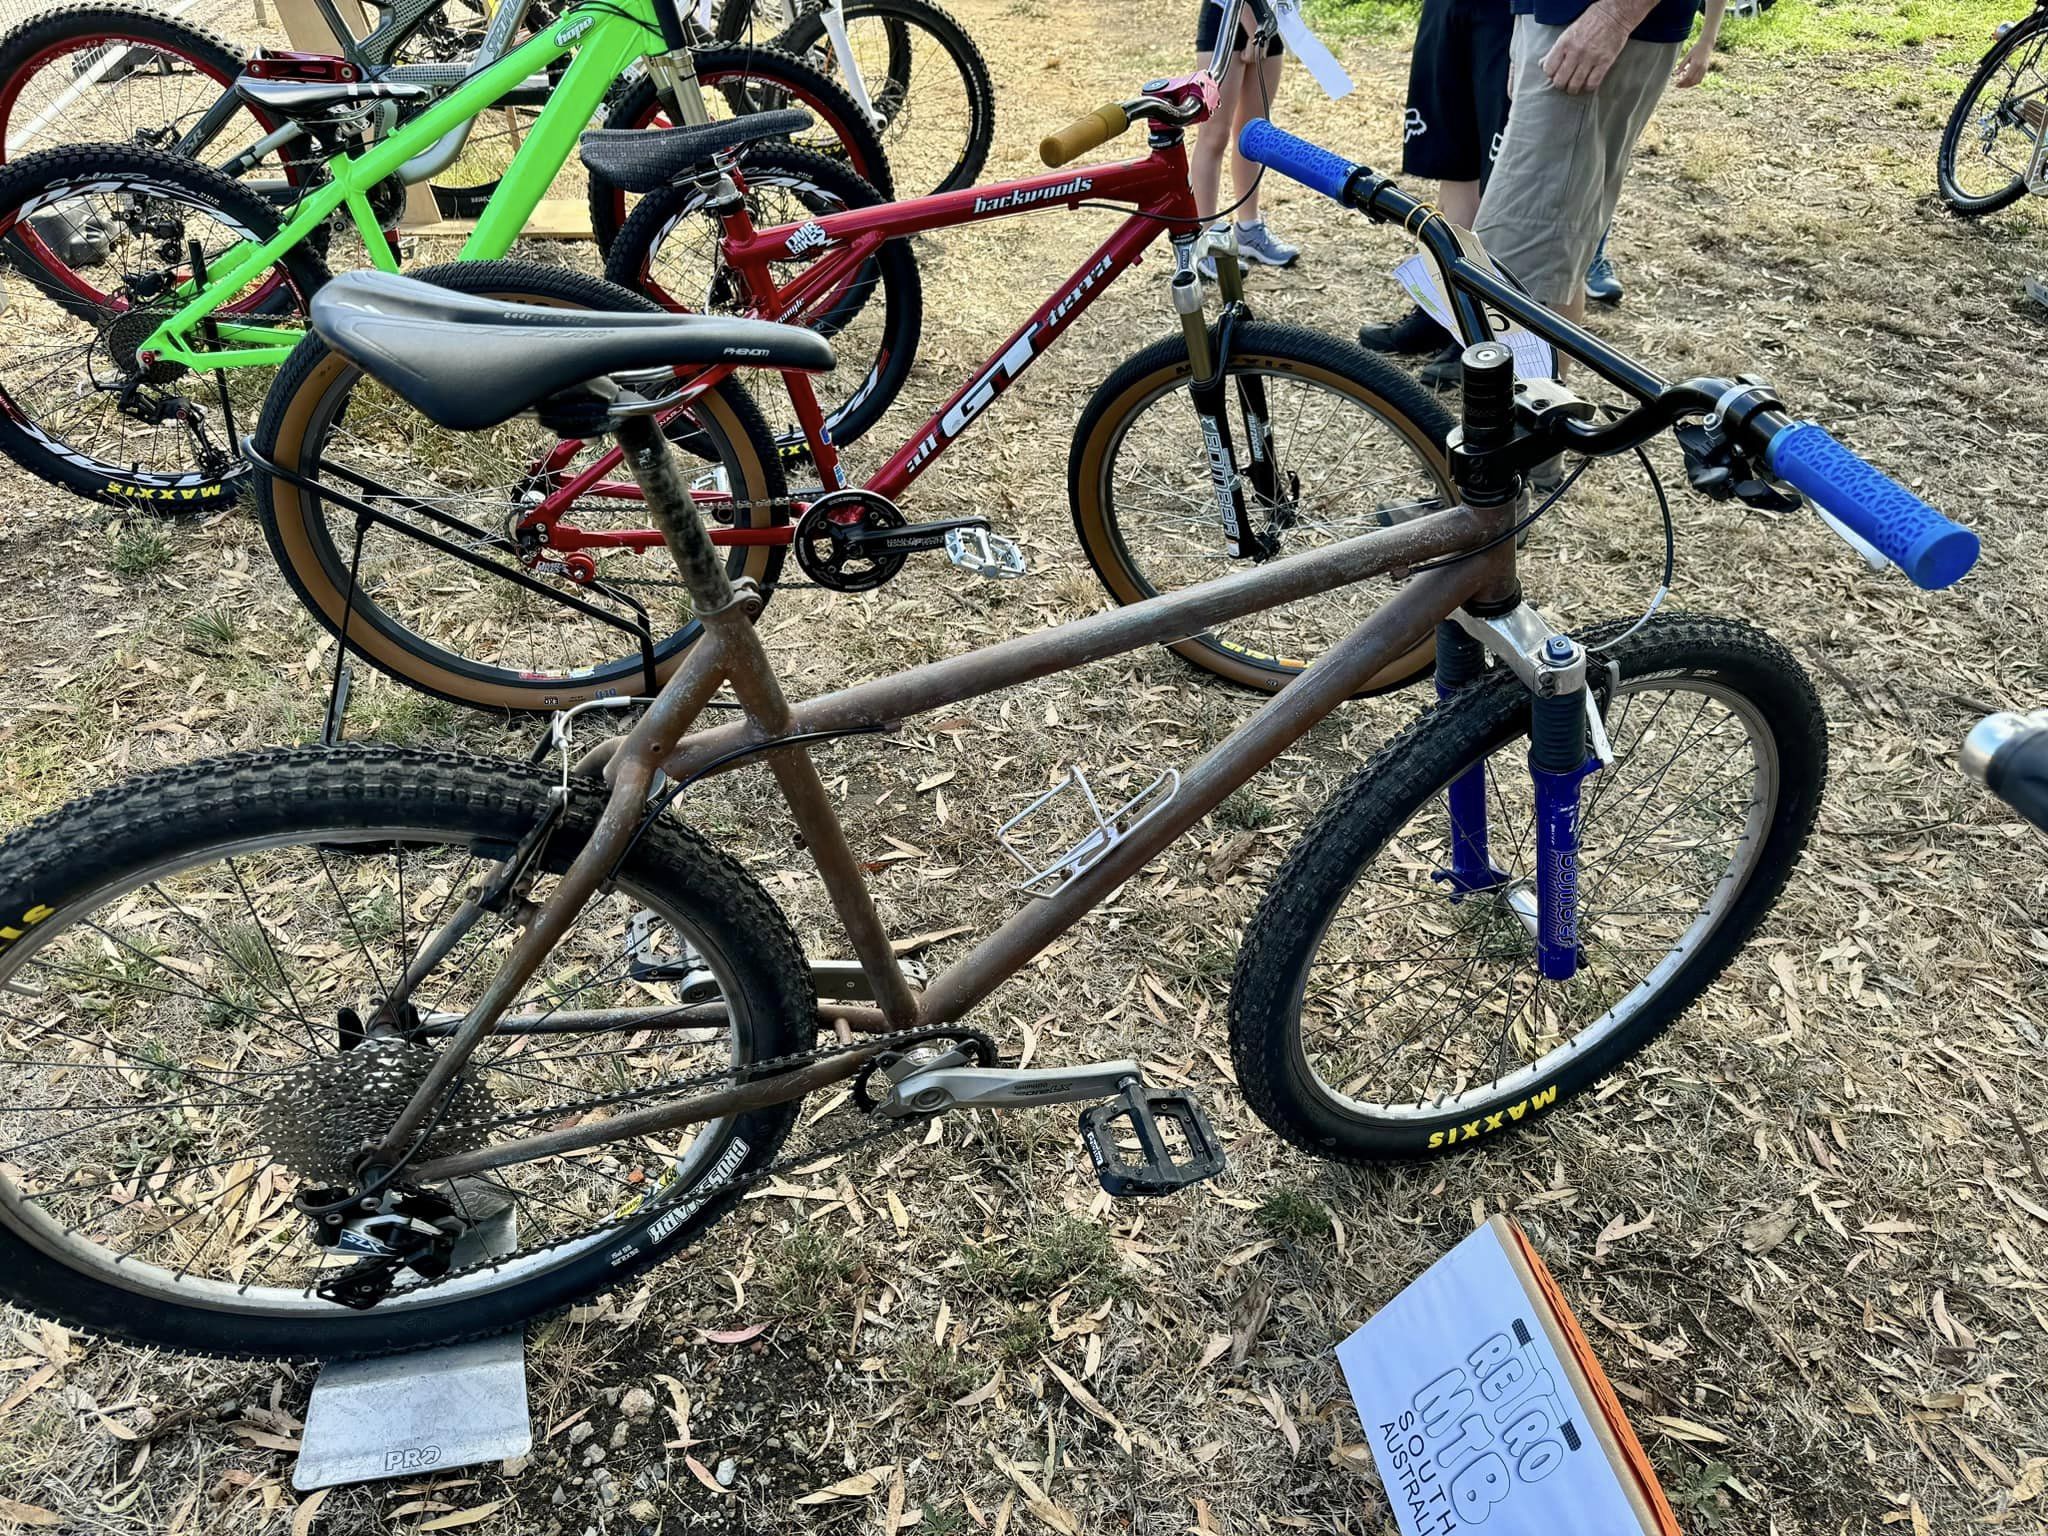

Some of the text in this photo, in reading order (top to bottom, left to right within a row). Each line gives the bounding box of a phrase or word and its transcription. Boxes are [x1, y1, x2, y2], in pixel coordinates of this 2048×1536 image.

[556, 17, 595, 46] hope
[973, 176, 1093, 214] backwoods
[785, 221, 822, 248] DMR
[791, 226, 827, 255] BIKES
[723, 347, 770, 357] PHENOM
[941, 322, 1039, 439] GT
[1047, 254, 1114, 327] terra
[106, 481, 222, 500] MAXXIS
[1203, 431, 1241, 540] BOMBER
[1427, 1084, 1557, 1149] MAXXIS
[1467, 1333, 1564, 1484] RETRO
[384, 1444, 442, 1471] PRO
[1413, 1367, 1511, 1525] MTB
[1379, 1421, 1436, 1536] AUSTRALI
[1398, 1410, 1457, 1536] SOUTH
